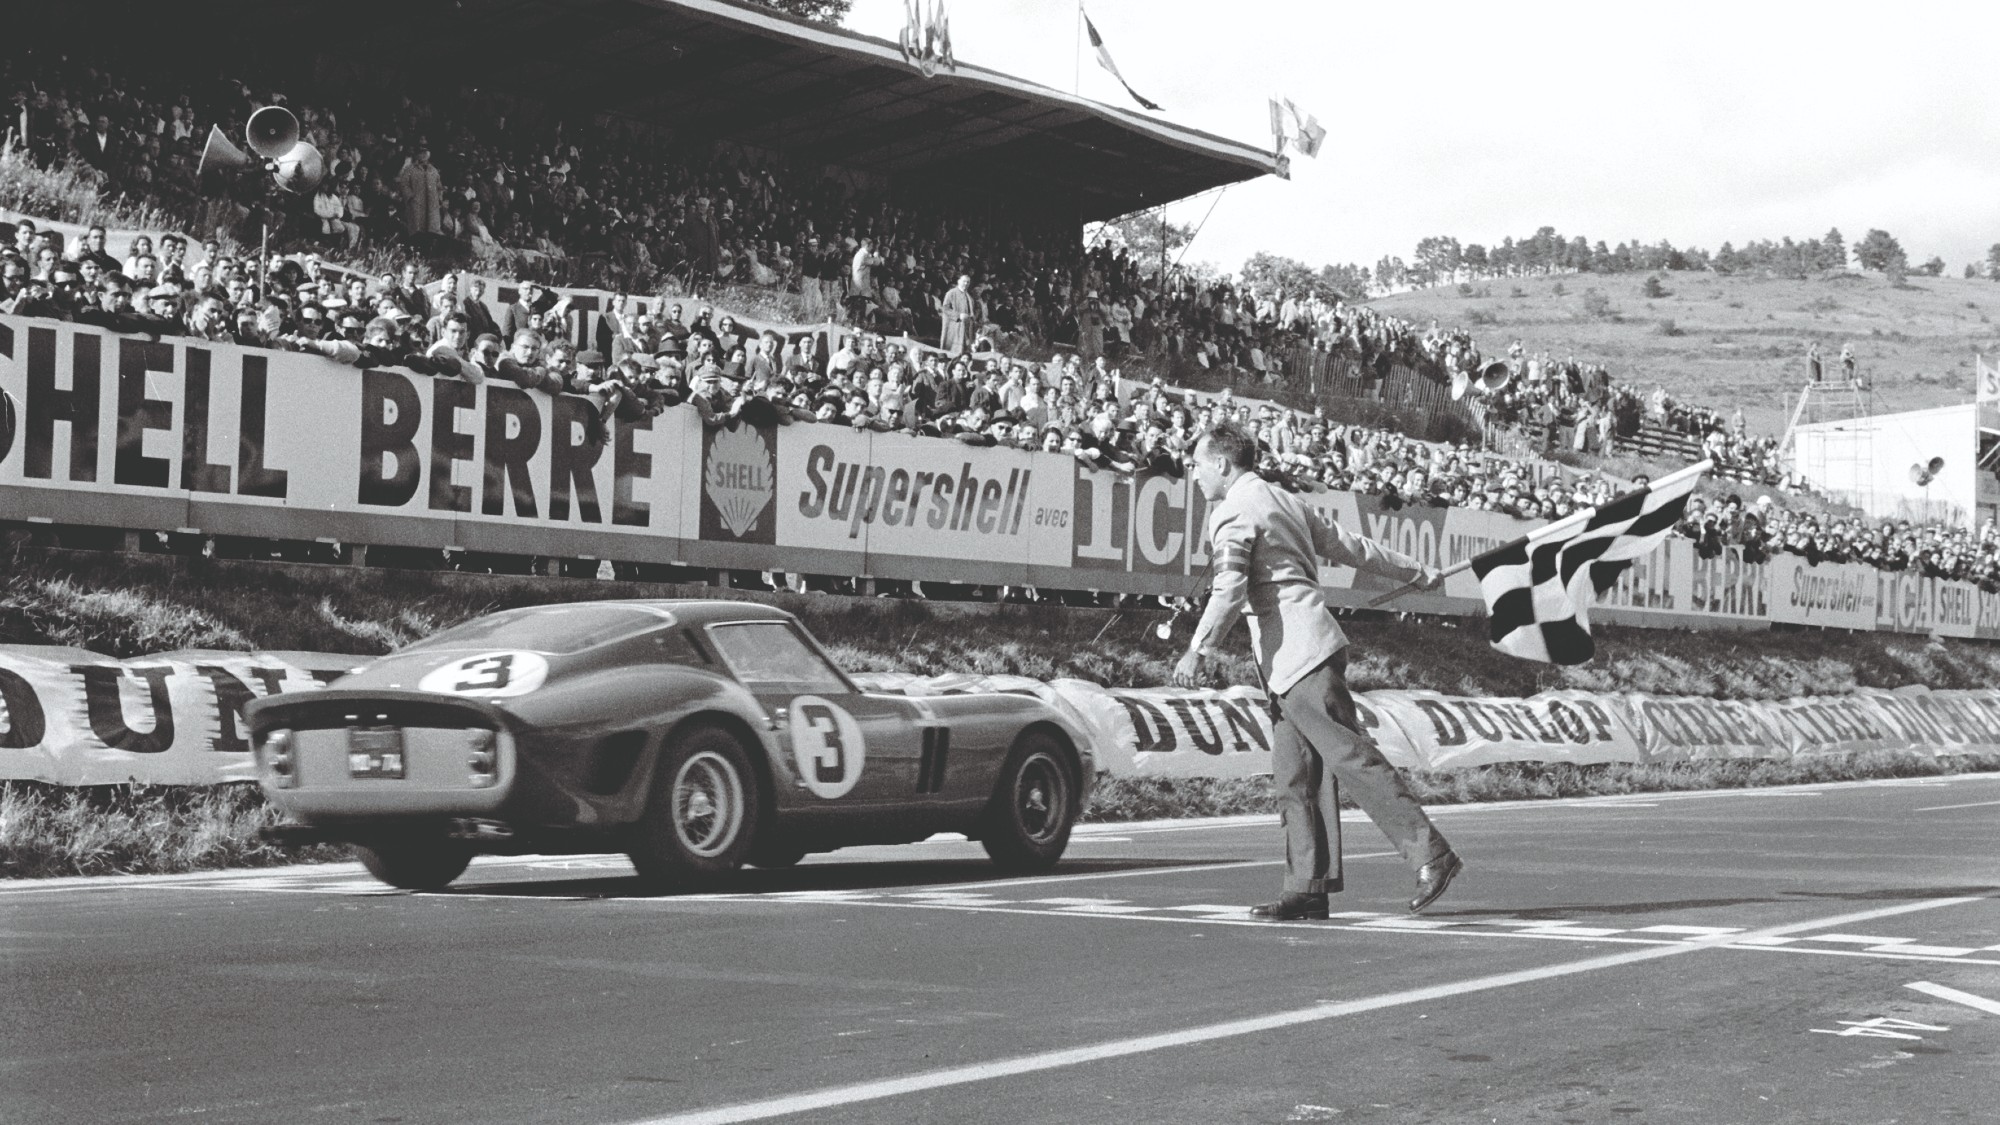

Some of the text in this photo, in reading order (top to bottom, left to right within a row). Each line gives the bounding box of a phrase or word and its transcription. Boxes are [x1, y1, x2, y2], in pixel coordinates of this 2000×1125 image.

[0, 323, 653, 527] HELL BERRE
[715, 461, 766, 491] SHELL
[798, 444, 1069, 539] Supershell avec
[1600, 537, 1675, 610] HELL
[1790, 565, 1865, 618] Supershell
[1939, 585, 1972, 626] SHELL
[454, 654, 514, 691] 3
[802, 704, 844, 783] 3
[1415, 698, 1614, 746] DUNLOP
